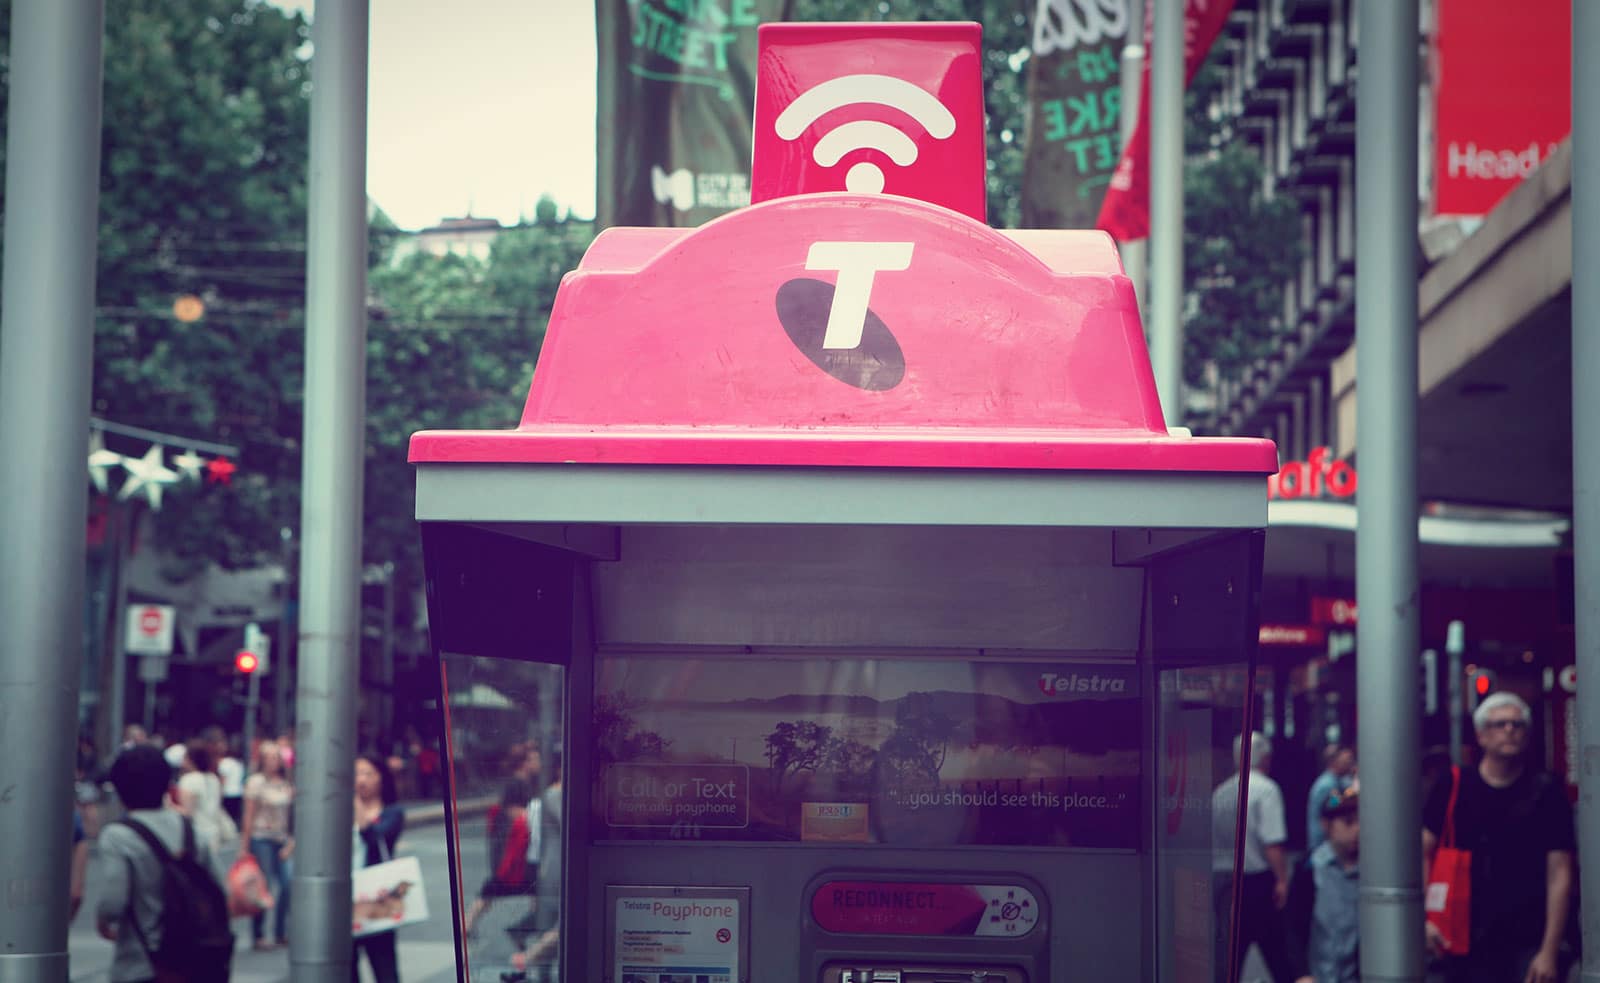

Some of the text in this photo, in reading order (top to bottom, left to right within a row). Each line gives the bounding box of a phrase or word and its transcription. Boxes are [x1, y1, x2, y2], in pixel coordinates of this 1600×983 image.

[805, 241, 915, 349] T
[1041, 672, 1125, 692] Telstra
[617, 777, 736, 798] Call or Text
[675, 801, 737, 817] payphone
[943, 791, 997, 807] should
[1001, 794, 1027, 807] see
[1031, 792, 1060, 808] this
[624, 901, 733, 921] Telstra Payphone
